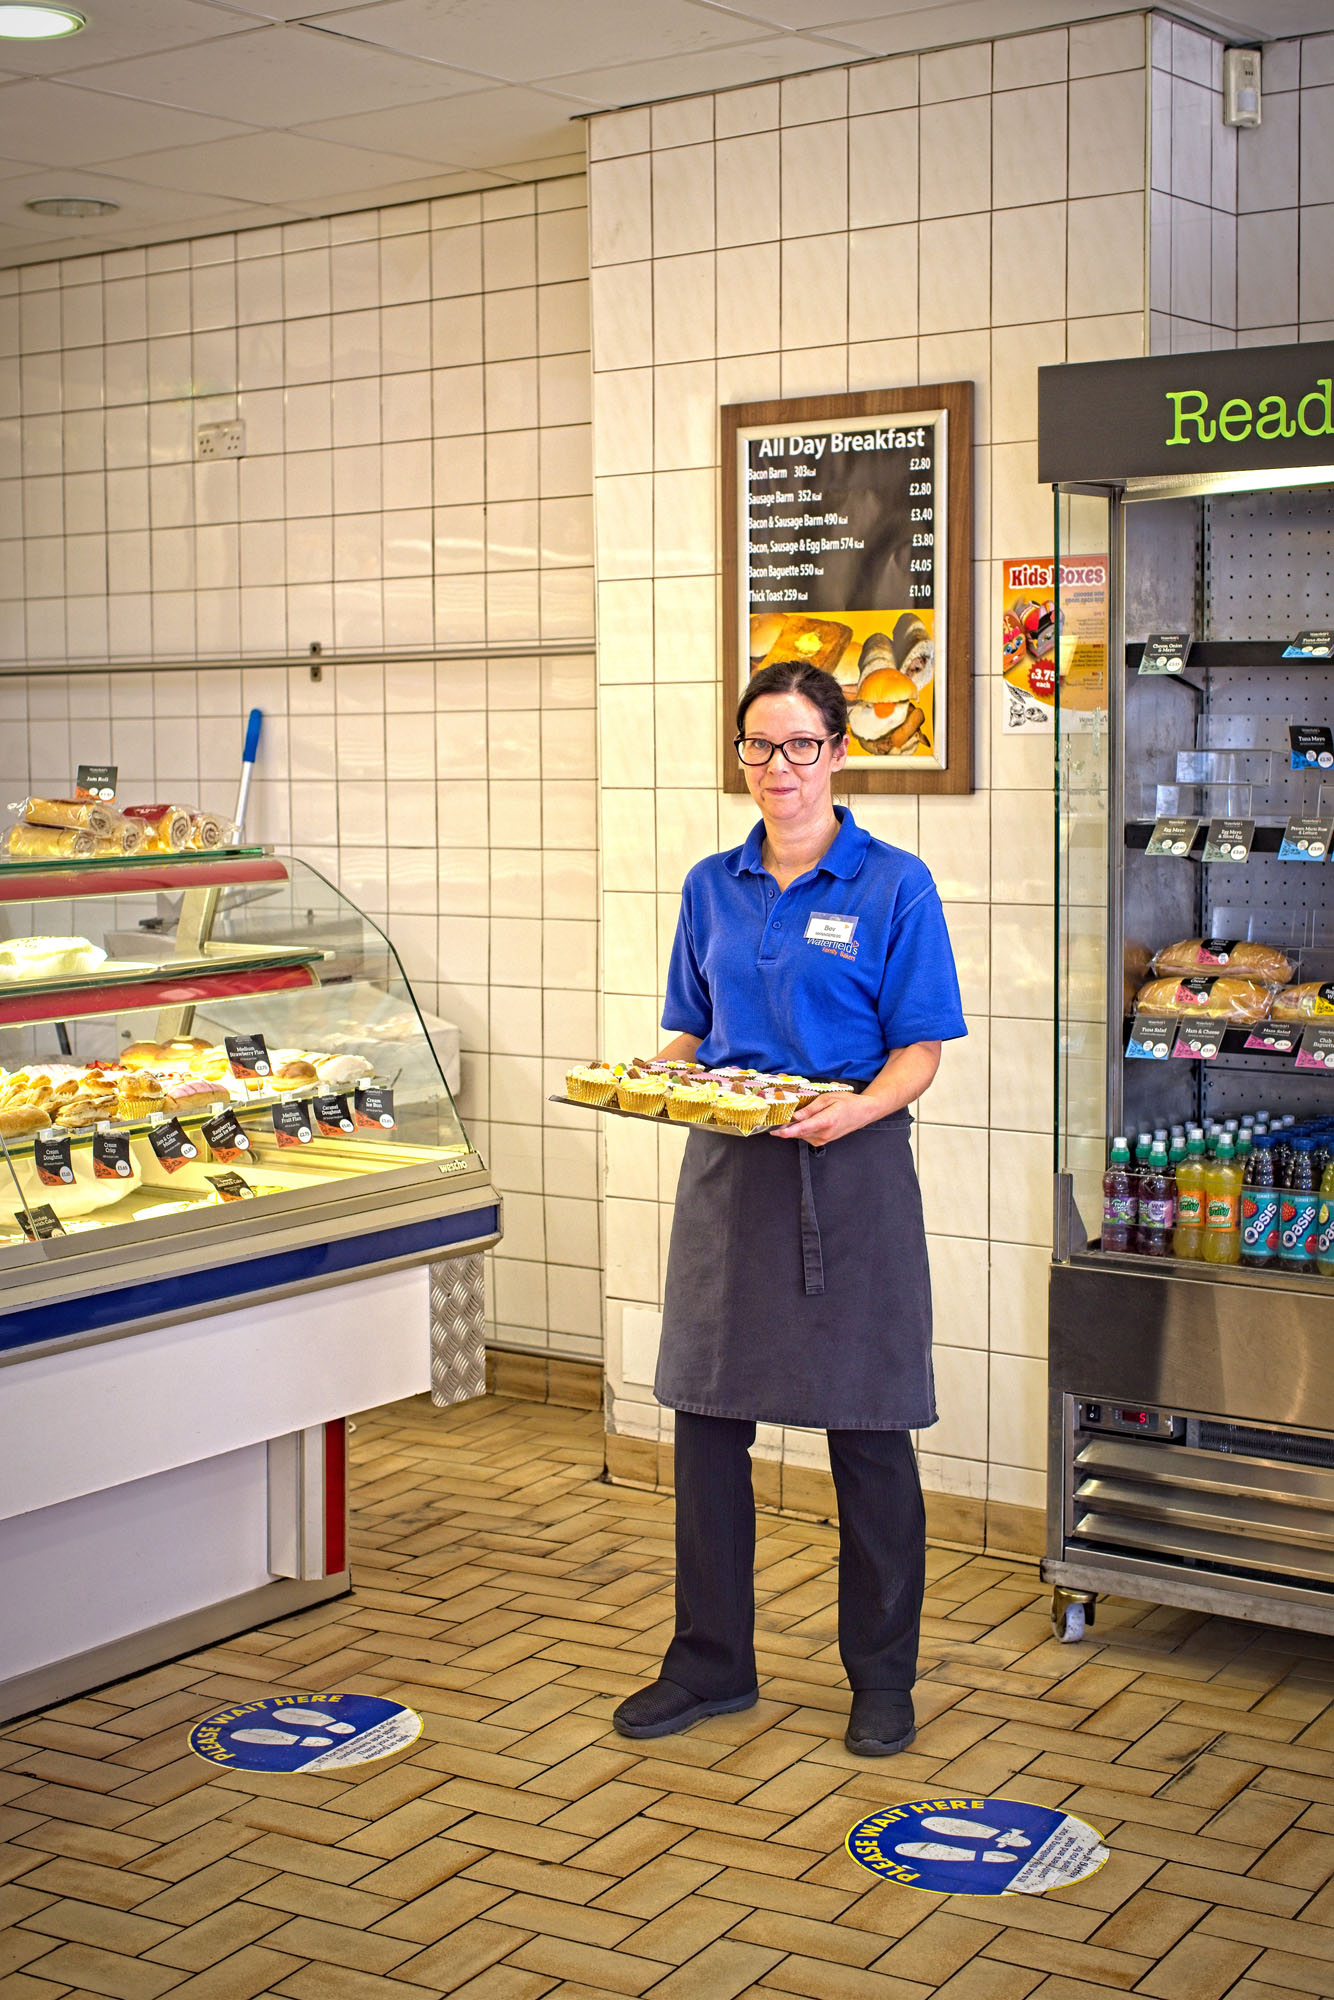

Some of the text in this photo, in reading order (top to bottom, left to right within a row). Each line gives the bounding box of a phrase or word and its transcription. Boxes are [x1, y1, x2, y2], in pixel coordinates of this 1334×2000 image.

[1165, 379, 1334, 446] Read
[758, 428, 926, 460] All Day Breakfast
[749, 469, 768, 480] Bacon
[769, 467, 787, 479] Barm
[910, 457, 931, 470] £2.80
[749, 493, 775, 507] Sausage
[776, 491, 794, 503] Barm
[797, 490, 812, 502] 352
[909, 482, 931, 496] £2.80
[749, 517, 768, 529] Bacon
[768, 516, 774, 528] &
[774, 515, 803, 530] Sausage
[804, 514, 823, 526] Barm
[824, 513, 838, 525] 490
[911, 508, 932, 521] £3.40
[749, 542, 769, 554] Bacon,
[770, 540, 798, 555] Sausage
[799, 539, 805, 551] &
[806, 538, 820, 554] Egg
[821, 538, 840, 550] Barm
[840, 537, 854, 549] 574
[912, 533, 934, 547] £3.80
[749, 566, 768, 578] Bacon
[768, 565, 799, 580] Baguette
[800, 564, 814, 576] 550
[910, 559, 932, 572] £4.05
[1011, 565, 1104, 587] Kids Boxes
[749, 590, 765, 602] Thick
[765, 589, 783, 601] Toast
[784, 589, 797, 600] 259
[909, 585, 931, 597] £1.10
[824, 924, 836, 932] Bev
[438, 1160, 468, 1173] wescho
[1245, 1202, 1277, 1244] Oasis
[1283, 1206, 1316, 1248] Oasis
[197, 1694, 344, 1761] PLEASE WAIT HERE
[855, 1800, 985, 1883] PLEASE WAIT HERE
